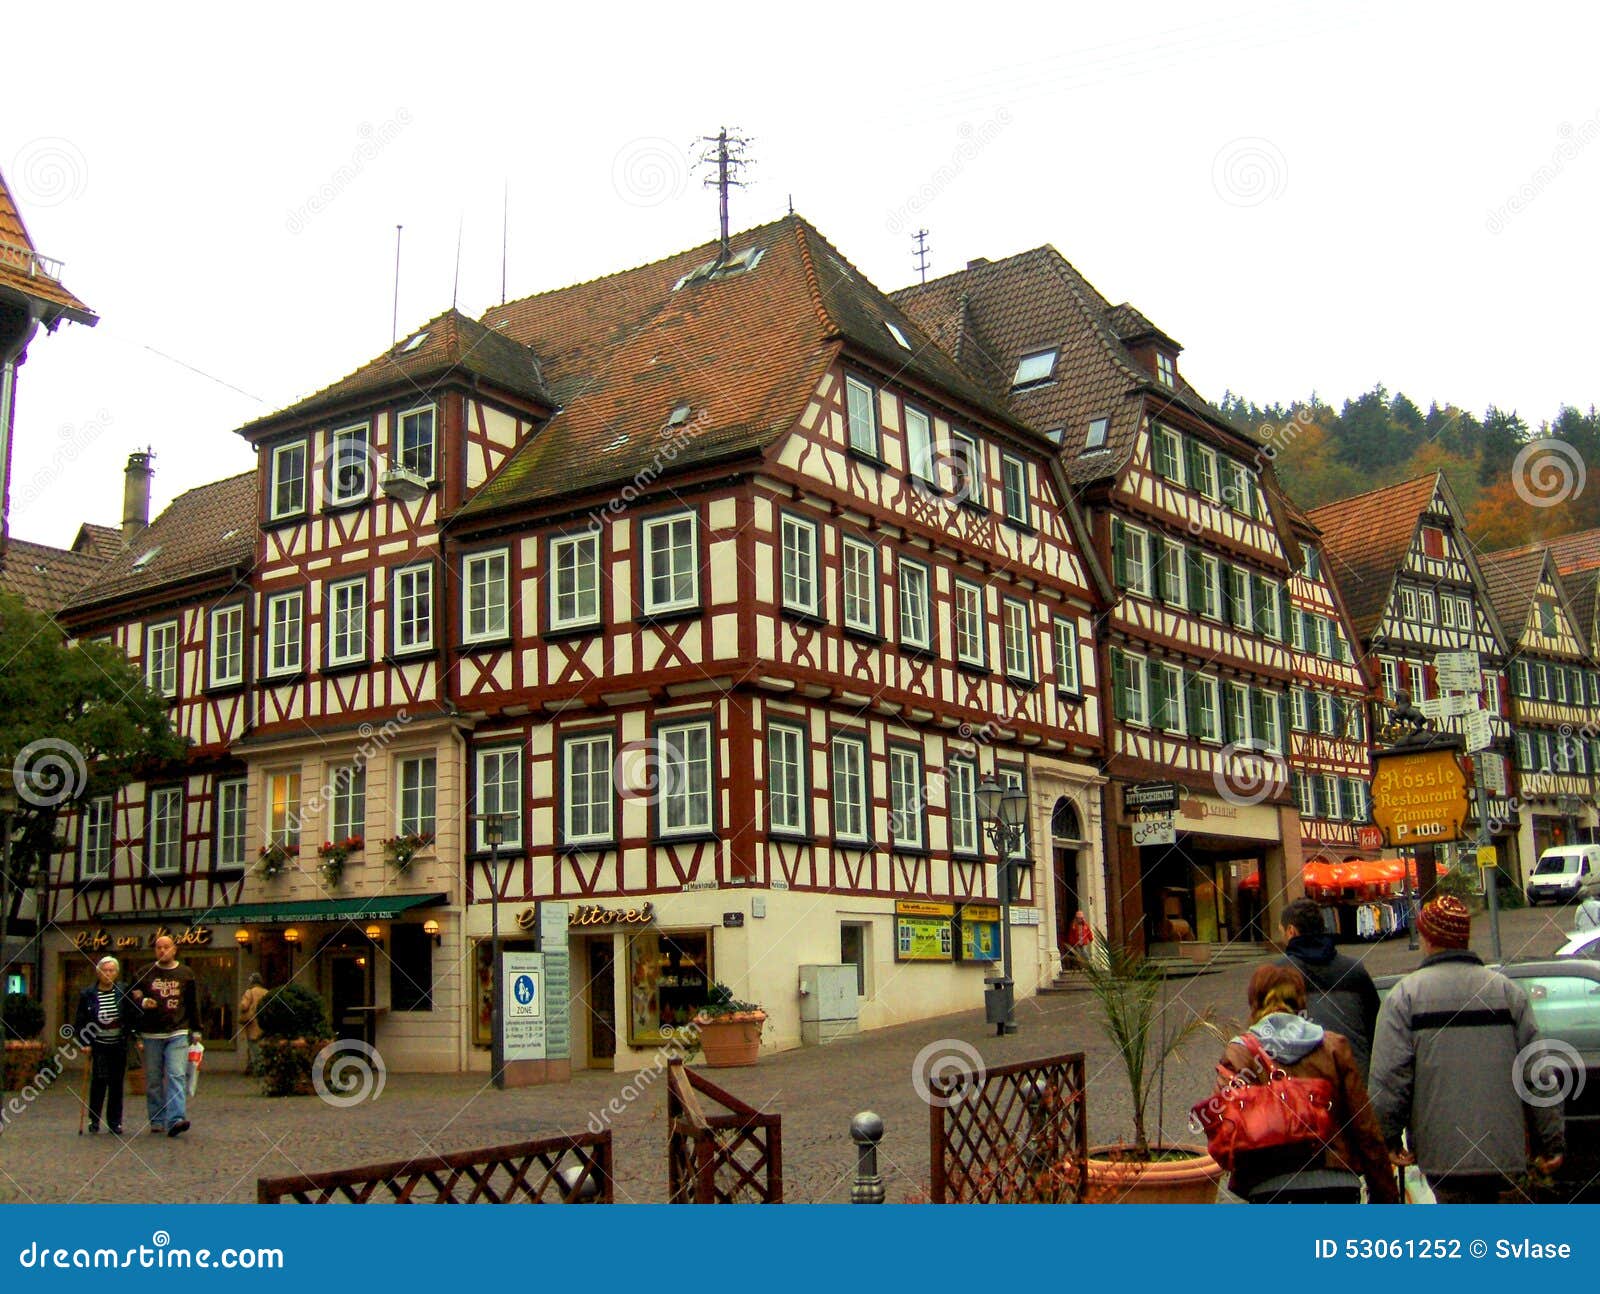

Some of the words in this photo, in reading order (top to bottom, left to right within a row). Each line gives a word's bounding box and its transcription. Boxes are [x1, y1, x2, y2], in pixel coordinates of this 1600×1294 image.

[1380, 764, 1455, 793] Rössle
[1381, 786, 1458, 808] Restaurant
[1393, 807, 1449, 823] Zimmer
[1396, 823, 1408, 839] P
[1361, 831, 1377, 848] kik
[117, 935, 139, 947] am
[516, 1006, 533, 1014] ZONE
